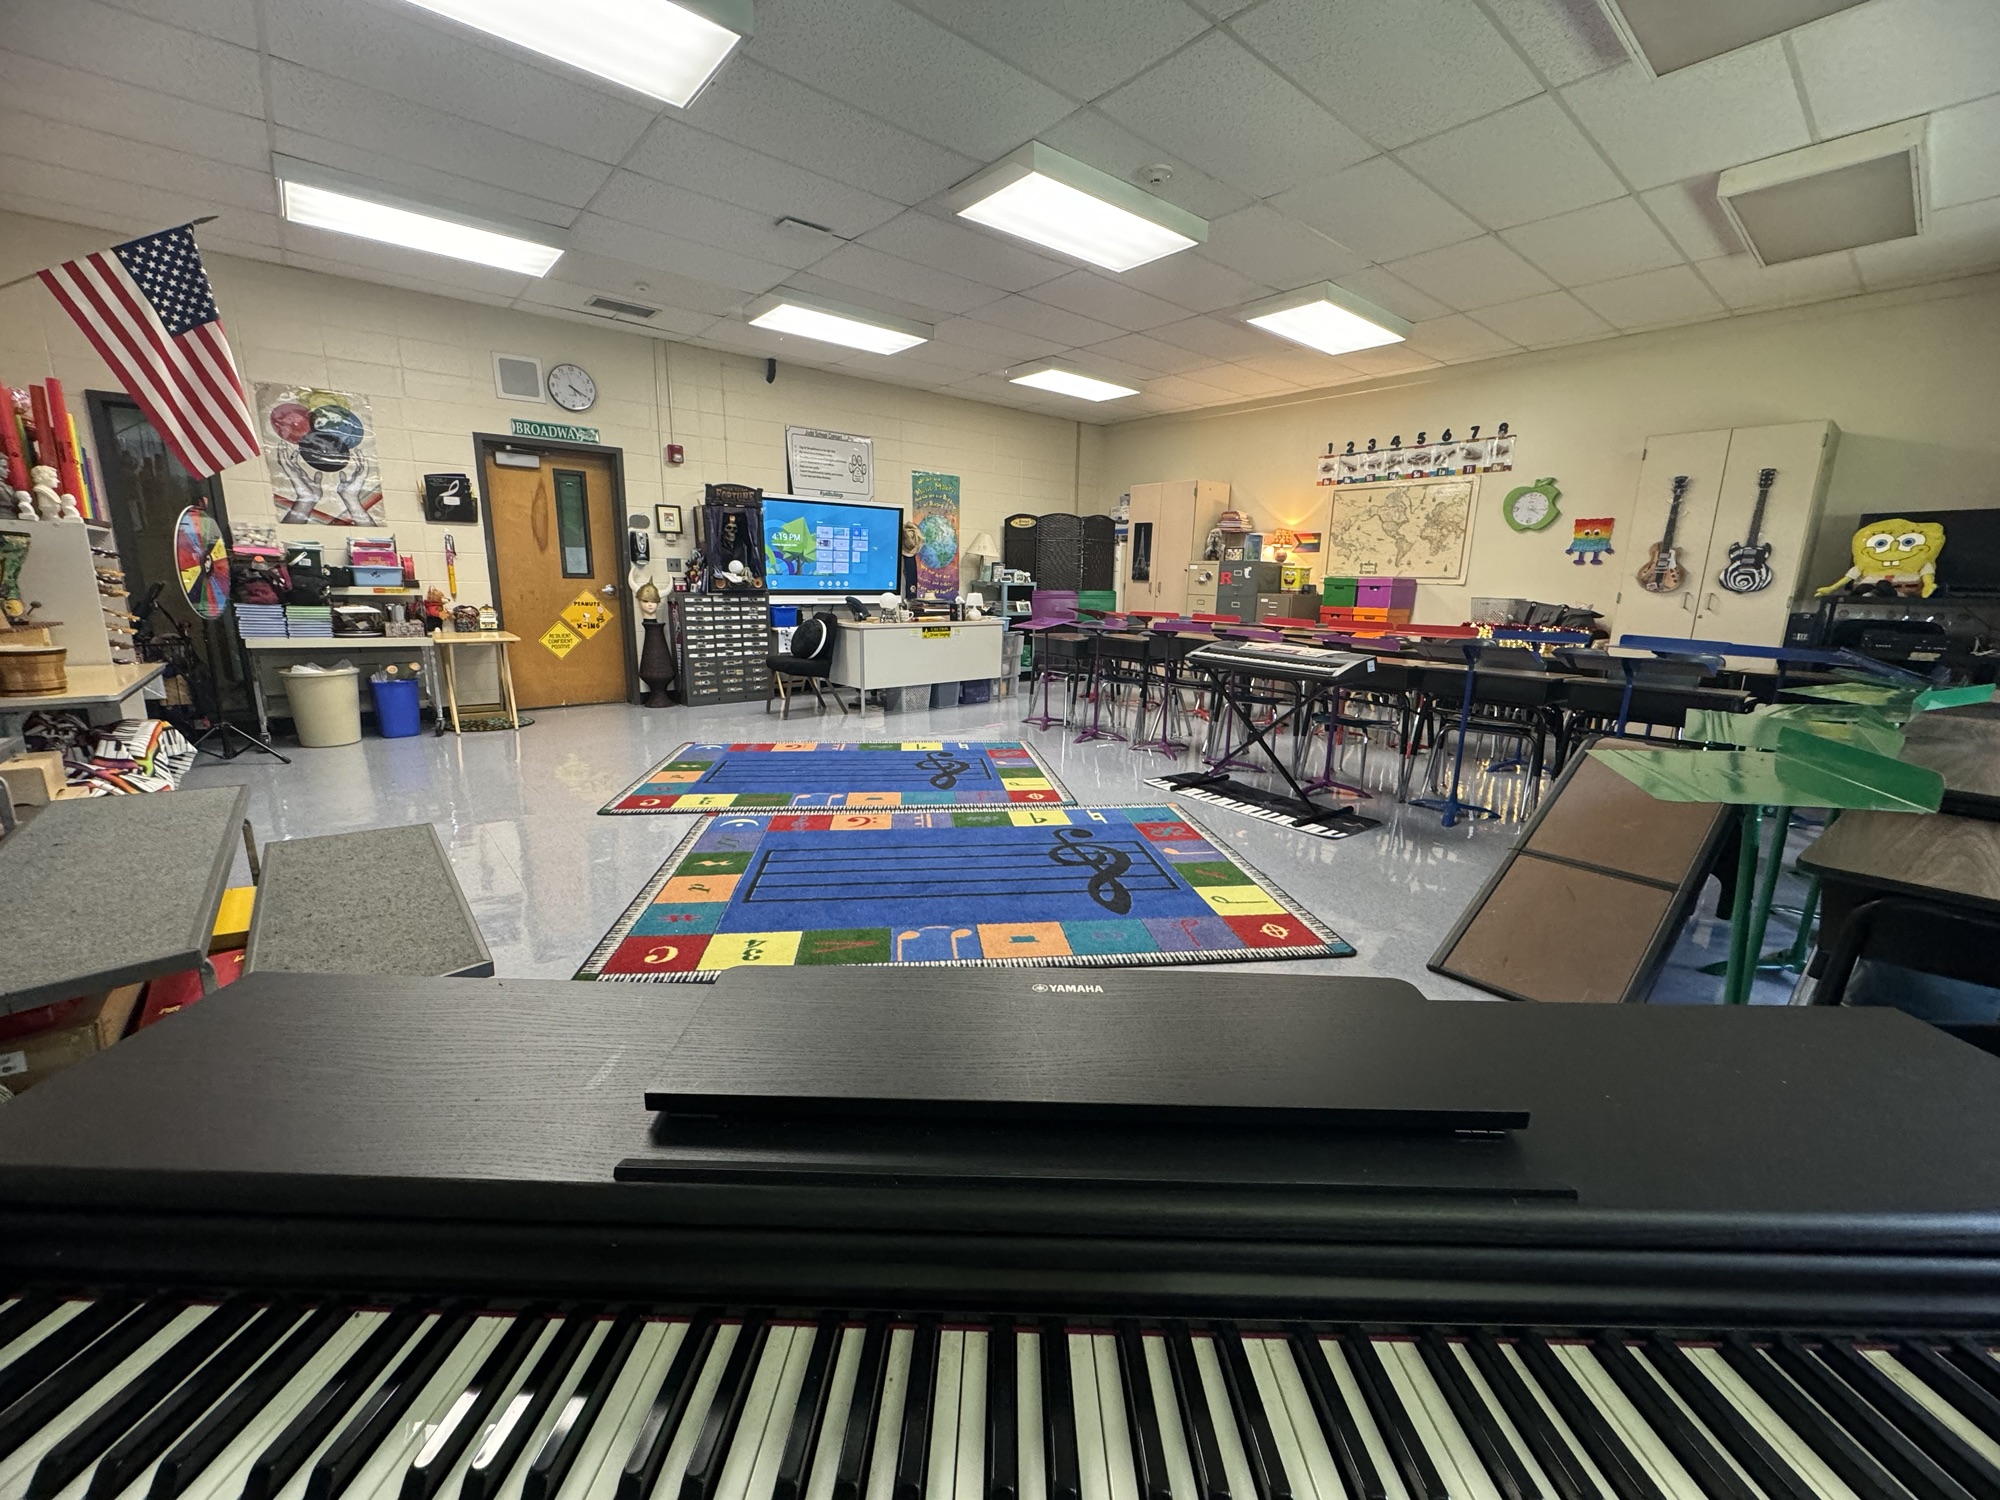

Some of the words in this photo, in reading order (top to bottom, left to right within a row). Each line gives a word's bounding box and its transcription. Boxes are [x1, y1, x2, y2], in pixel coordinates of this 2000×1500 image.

[516, 421, 583, 441] BROADWAY
[1328, 442, 1333, 454] 1
[1346, 441, 1355, 454] 2
[1367, 438, 1376, 451] 3
[1390, 435, 1401, 448] 4
[1417, 431, 1426, 445] 5
[1442, 428, 1452, 442] 6
[1470, 425, 1480, 439] 7
[1498, 422, 1509, 438] 8
[715, 488, 755, 500] FORTUNE
[771, 532, 788, 541] 4:19
[789, 533, 801, 542] PM
[1219, 571, 1233, 585] R
[1048, 984, 1104, 993] YAMAHA
